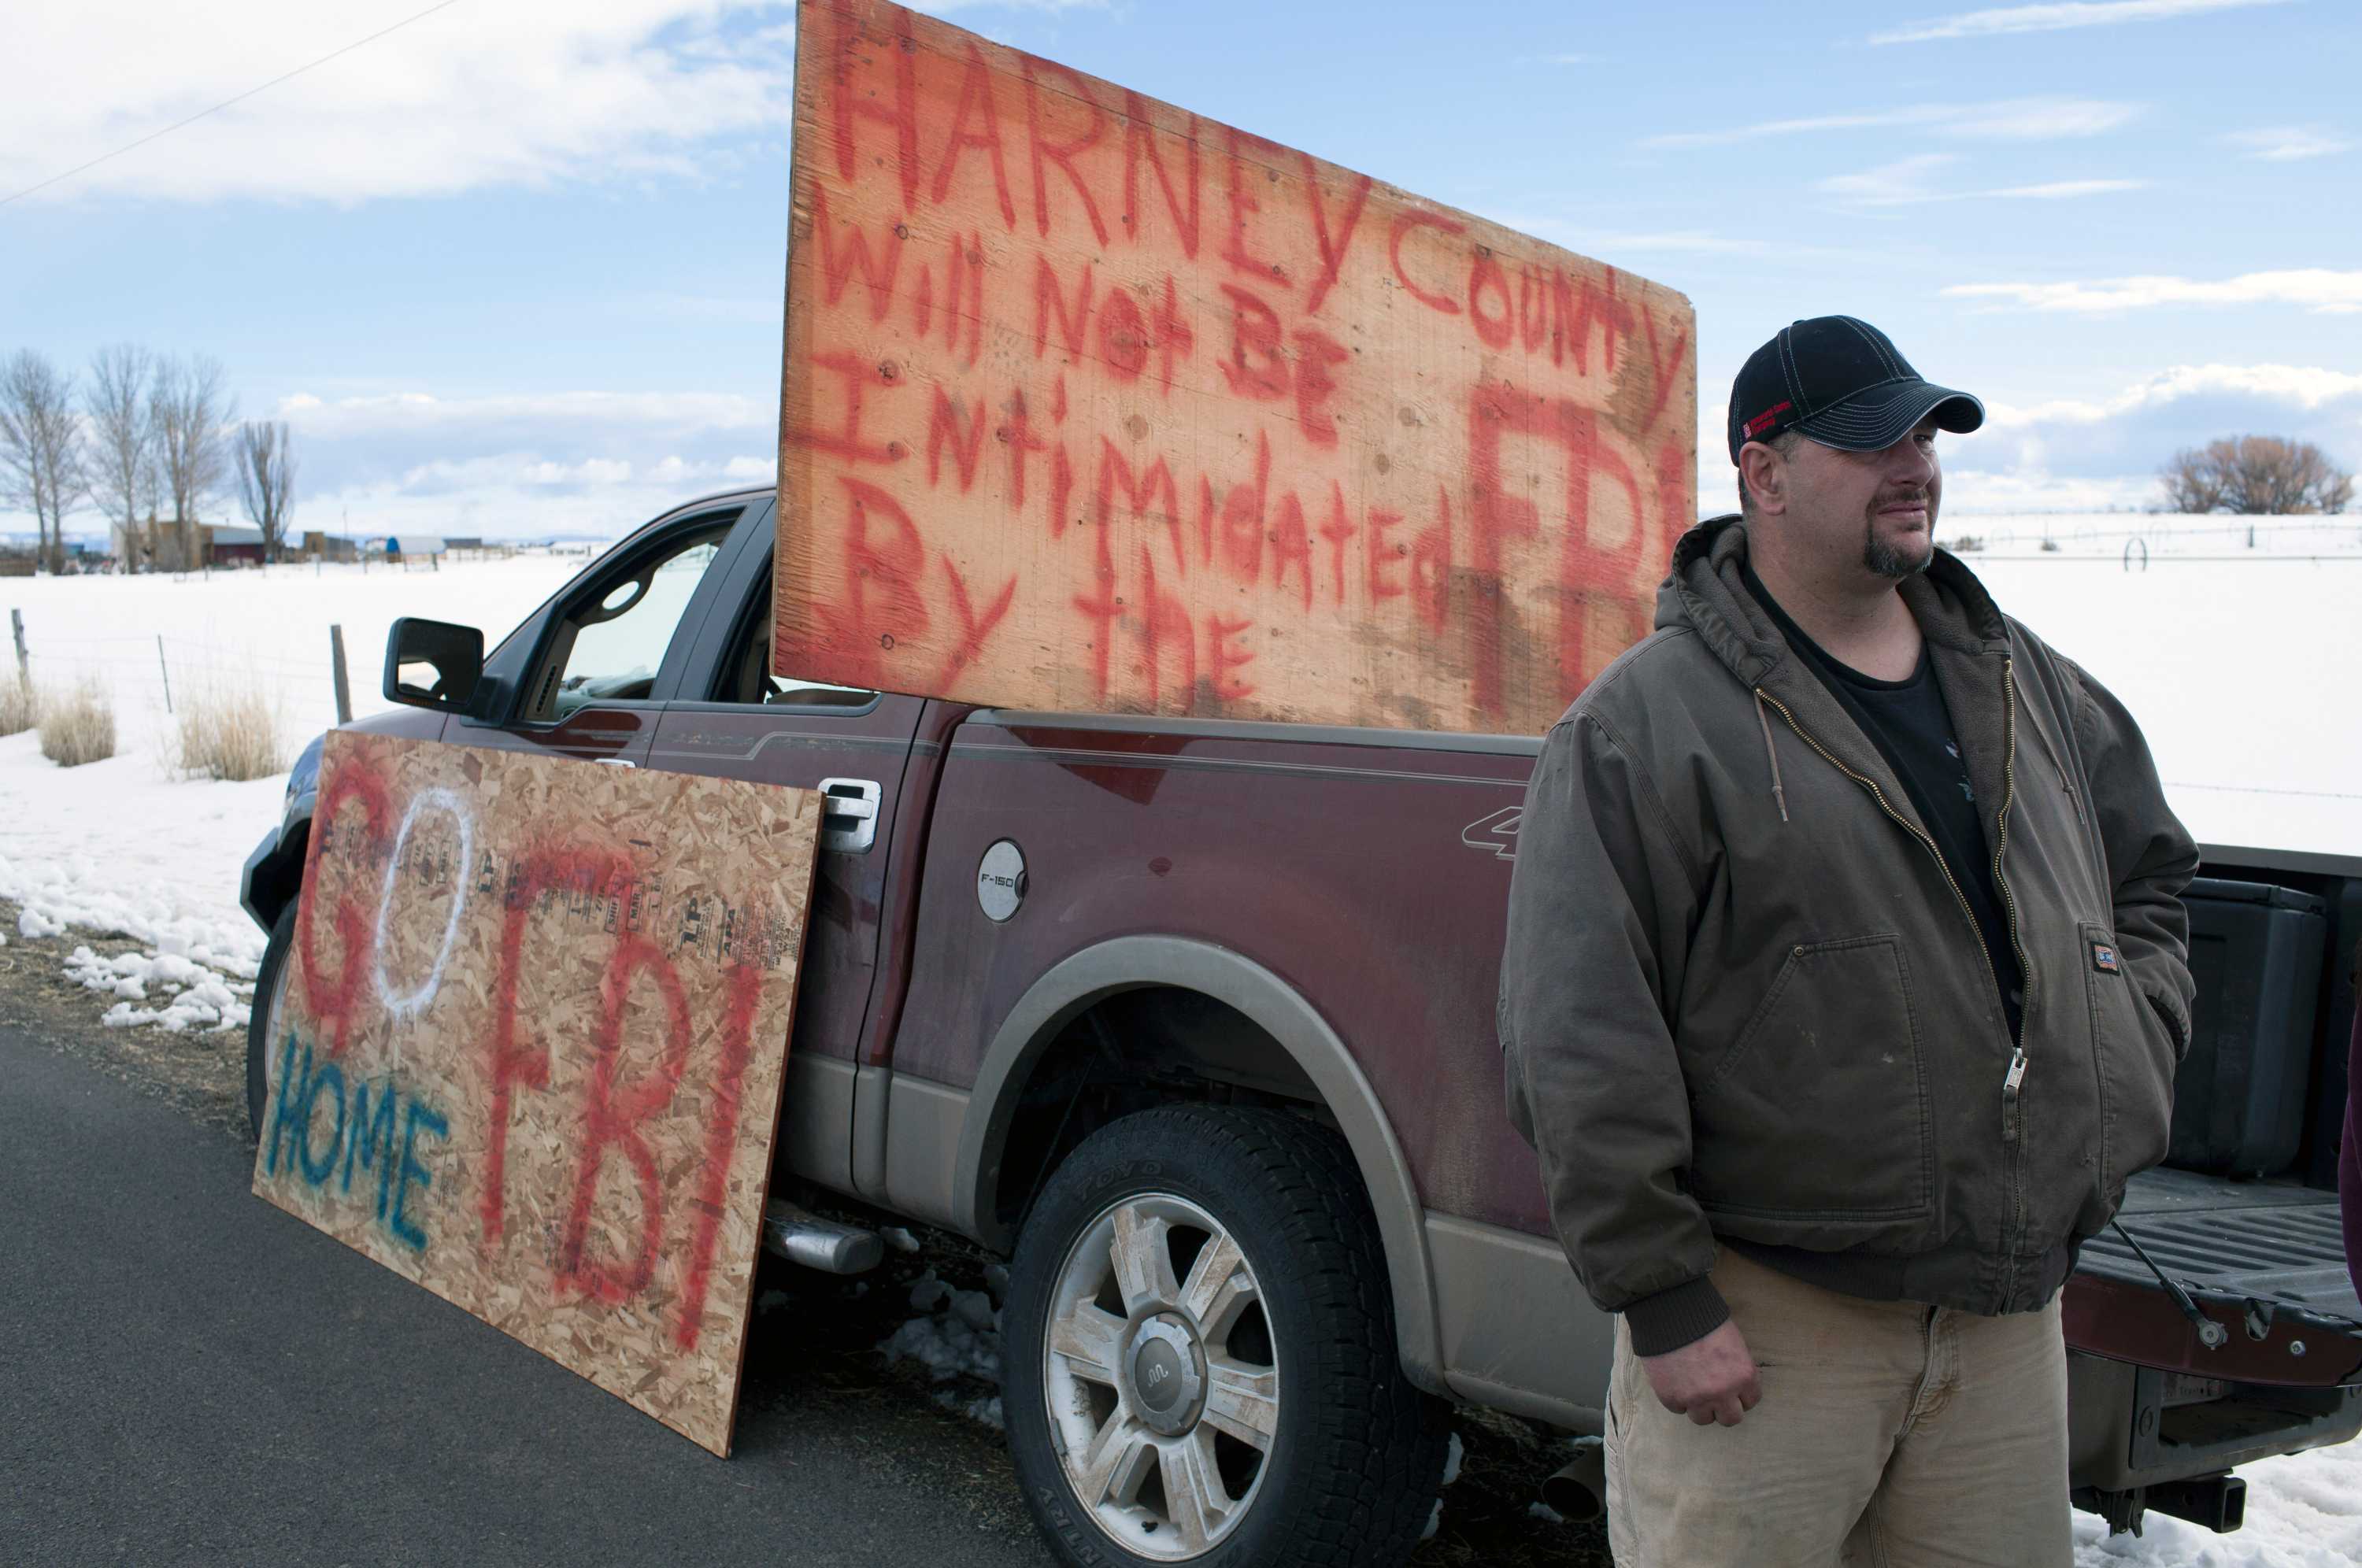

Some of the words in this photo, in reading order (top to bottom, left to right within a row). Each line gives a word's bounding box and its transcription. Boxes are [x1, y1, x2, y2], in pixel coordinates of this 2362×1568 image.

[831, 8, 1373, 313] HARNEY
[1214, 280, 1351, 451] BE
[805, 477, 1019, 697] BY
[1469, 386, 1686, 720] FBI
[296, 758, 472, 1059] GO
[630, 893, 642, 920] MAR
[981, 873, 1014, 888] F-150
[265, 1031, 450, 1252] HOME
[476, 844, 764, 1352] FBI
[1076, 1159, 1164, 1204] TOYO
